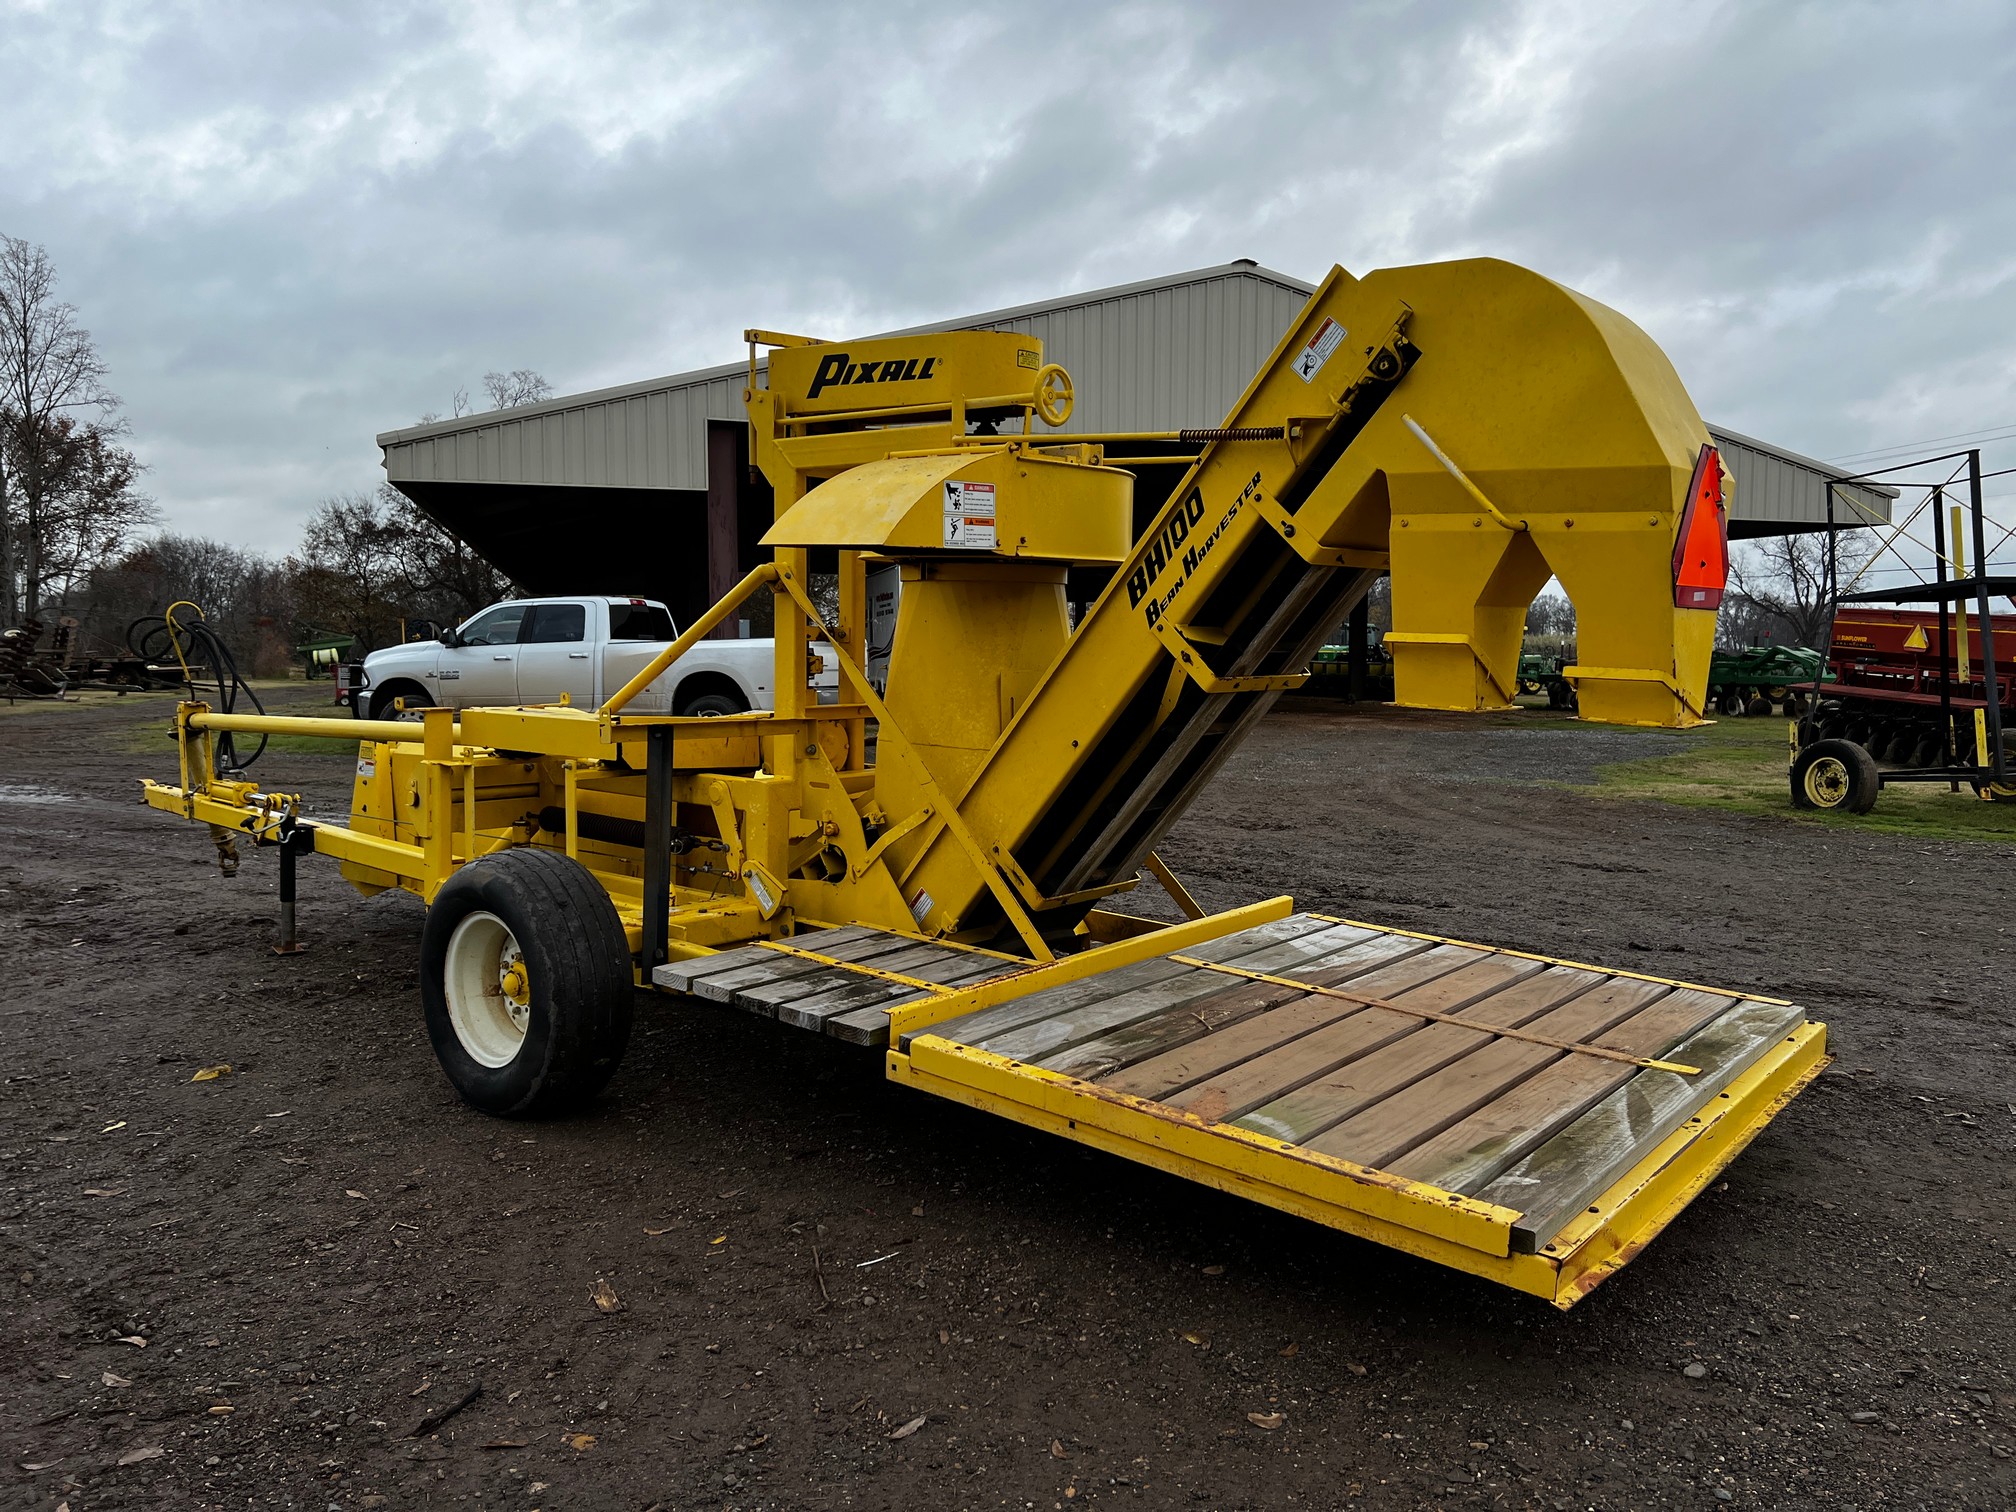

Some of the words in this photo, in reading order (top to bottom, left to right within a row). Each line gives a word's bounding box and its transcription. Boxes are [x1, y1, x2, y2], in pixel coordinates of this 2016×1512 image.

[806, 353, 936, 399] PIXALL
[1126, 486, 1205, 611] BH100
[1145, 576, 1184, 630] BEAN
[1182, 471, 1262, 580] HARVESTER
